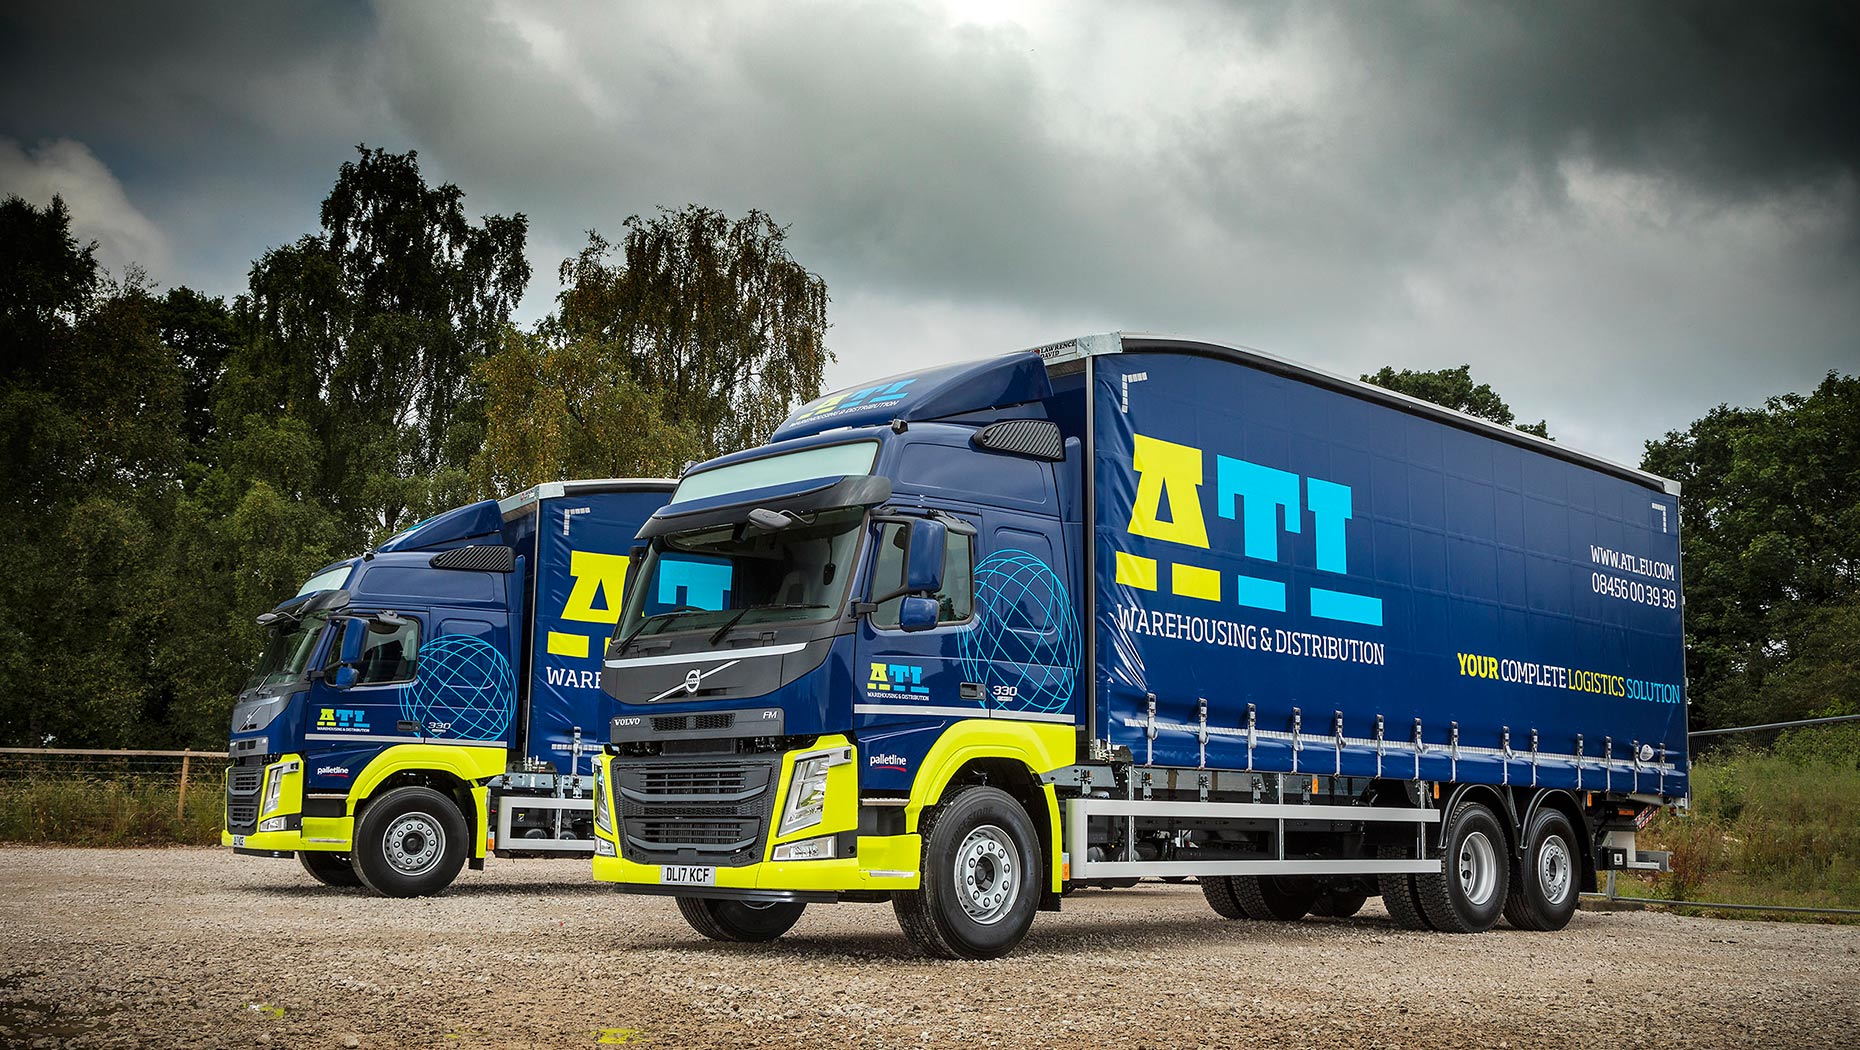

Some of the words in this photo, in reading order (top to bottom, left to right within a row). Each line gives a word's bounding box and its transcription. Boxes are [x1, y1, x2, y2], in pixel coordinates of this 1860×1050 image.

[1040, 341, 1077, 354] LAWRENCE
[1040, 350, 1060, 360] DAVID
[797, 378, 919, 420] ATL
[1115, 433, 1384, 627] ATL
[1590, 544, 1675, 581] WWW.ATL.EU.COM
[1592, 572, 1629, 600] 08456
[1630, 581, 1645, 604] 00
[1646, 585, 1661, 607] 39
[1662, 589, 1677, 609] 39
[1117, 603, 1257, 650] WAREHOUSING
[1260, 626, 1273, 652] &
[1275, 629, 1385, 666] DISTRIBUTION
[867, 662, 929, 693] ATL
[1457, 652, 1499, 680] YOUR
[1501, 659, 1567, 689] COMPLETE
[1568, 668, 1625, 698] LOGISTICS
[1626, 678, 1681, 704] SOLUTION
[992, 685, 1018, 696] 330
[317, 708, 370, 728] ATL
[614, 718, 641, 726] VOLVO
[762, 711, 779, 719] FM
[428, 721, 452, 730] 330
[869, 754, 907, 767] palletline
[666, 867, 687, 882] DL17
[689, 867, 710, 882] KCF
